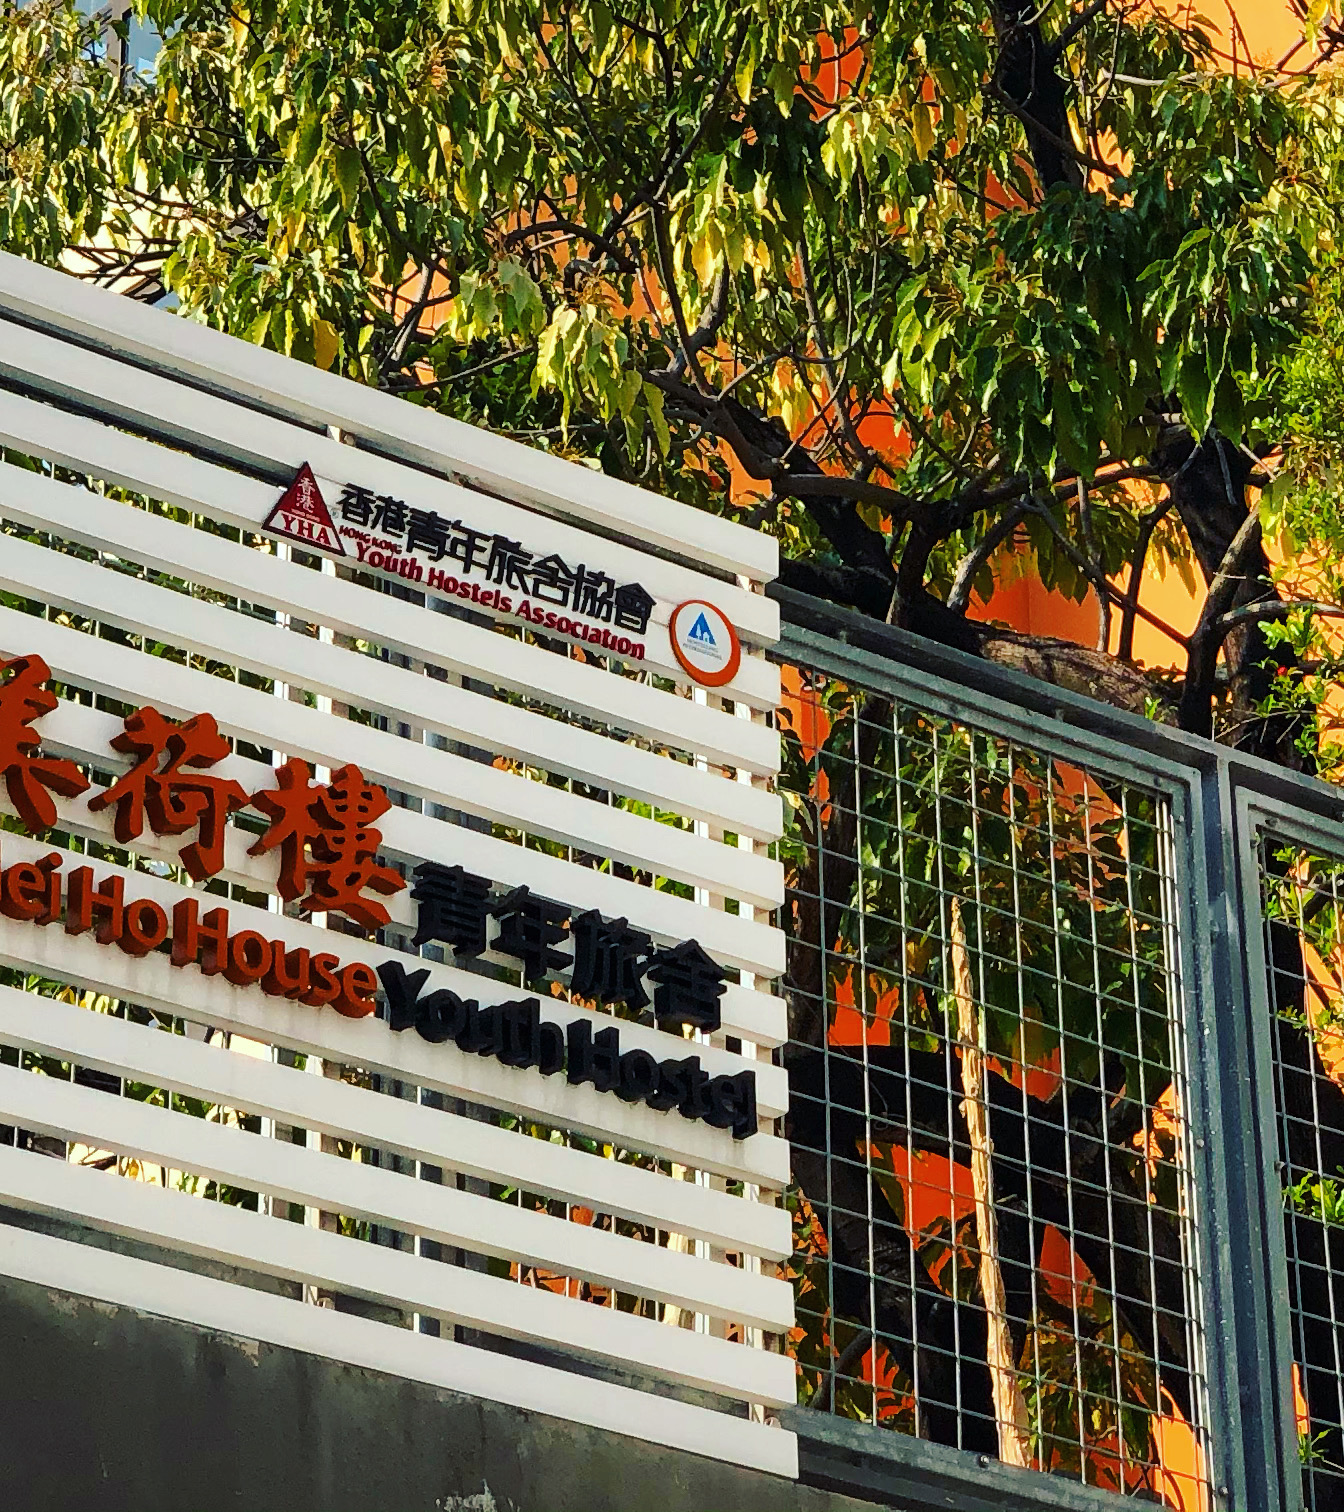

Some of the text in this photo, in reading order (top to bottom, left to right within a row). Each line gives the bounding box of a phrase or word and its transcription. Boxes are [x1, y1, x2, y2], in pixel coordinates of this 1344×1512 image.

[281, 513, 333, 547] YHA
[295, 477, 316, 513] 香港
[336, 482, 657, 635] 香港青年旅舍協會
[338, 524, 403, 555] HONG KONG
[356, 541, 424, 582] Youth
[427, 566, 513, 613] Hostels
[515, 599, 646, 661] Association
[375, 959, 565, 1076] Youth
[565, 1017, 759, 1141] Hostel
